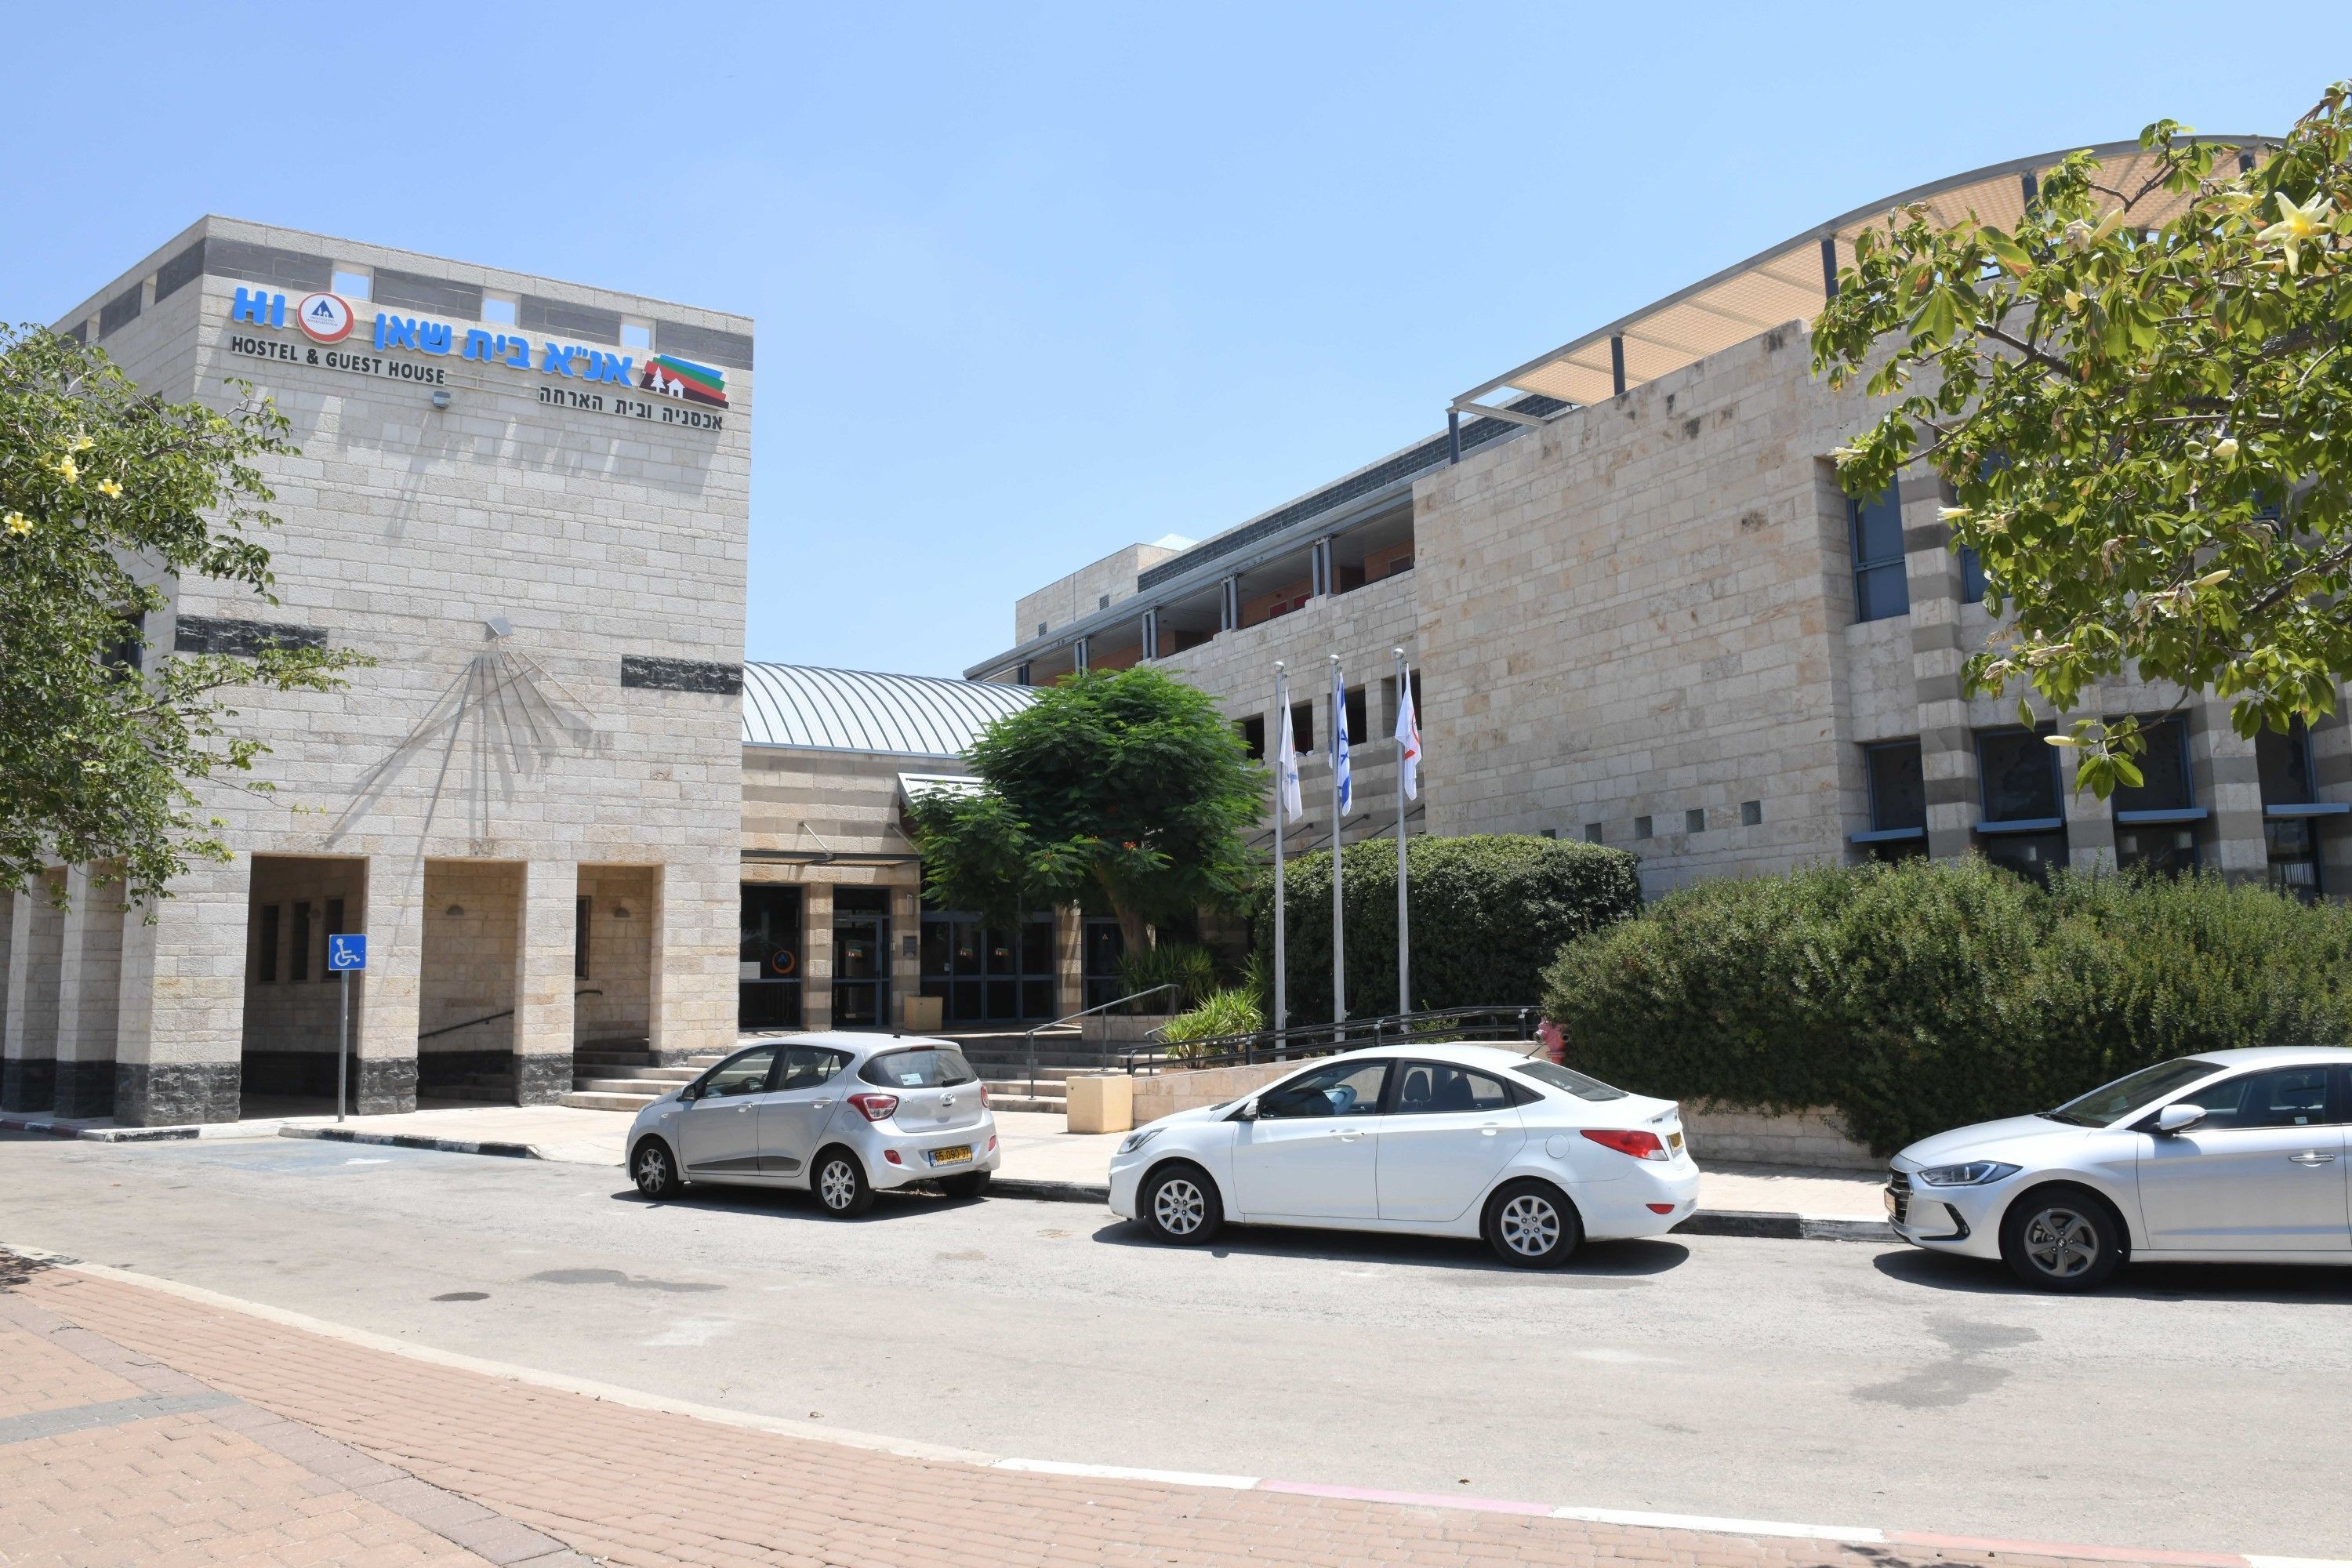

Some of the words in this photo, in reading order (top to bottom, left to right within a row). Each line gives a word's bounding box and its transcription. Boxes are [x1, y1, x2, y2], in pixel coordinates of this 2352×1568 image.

[234, 287, 285, 328] HI
[375, 313, 452, 354] שאן
[463, 328, 531, 369] בית
[232, 336, 298, 361] HOSTEL
[307, 348, 319, 365] &
[326, 352, 382, 374] GUEST
[388, 361, 445, 384] HOUSE
[540, 387, 603, 411] הארחה
[615, 399, 652, 419] ובית
[663, 407, 723, 430] אכסניה
